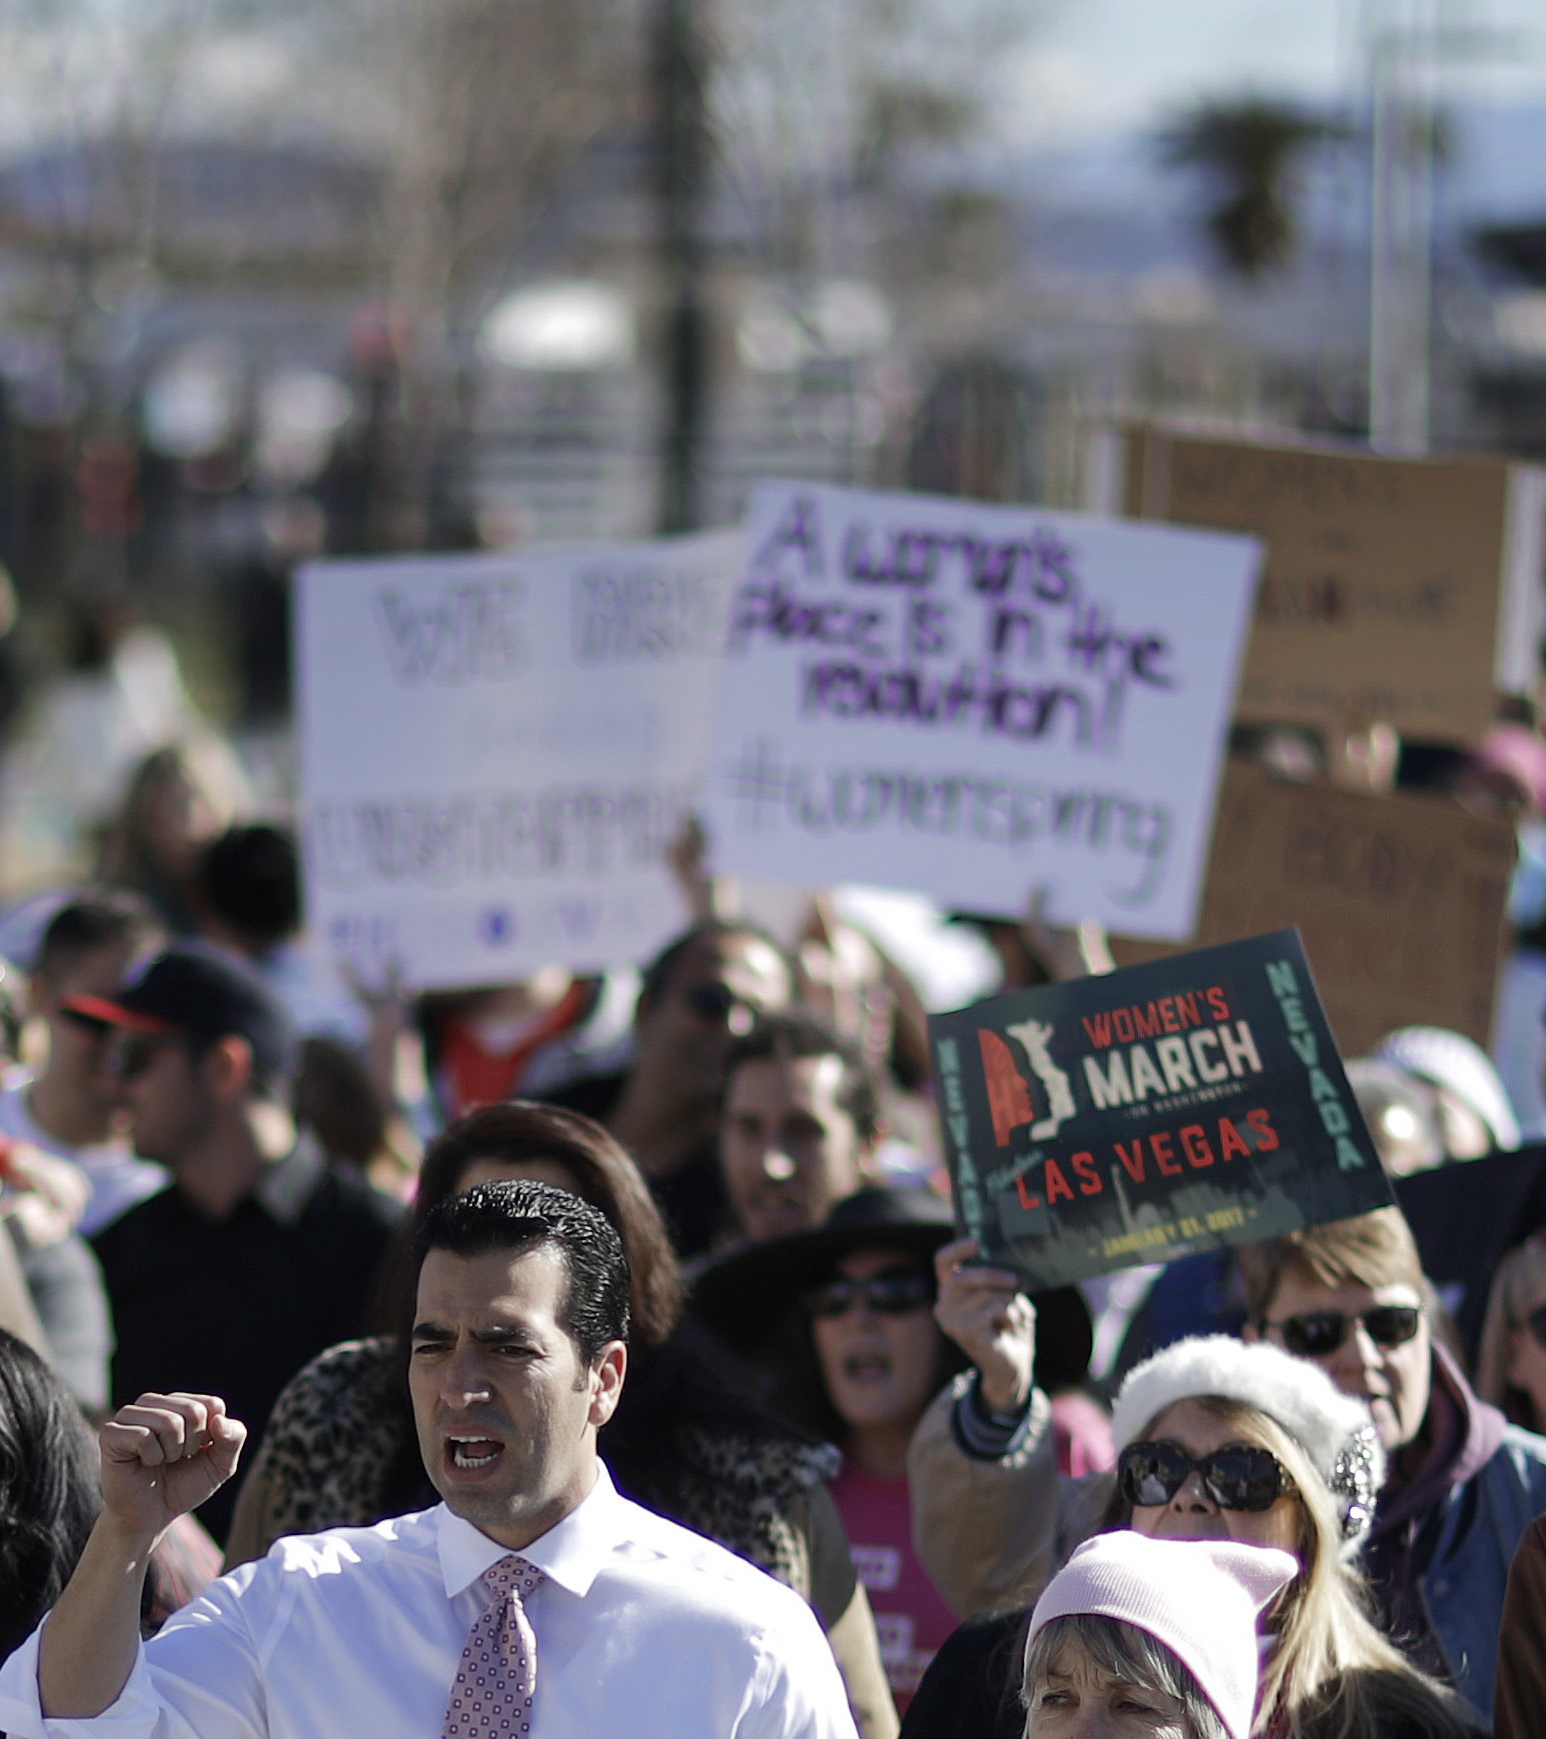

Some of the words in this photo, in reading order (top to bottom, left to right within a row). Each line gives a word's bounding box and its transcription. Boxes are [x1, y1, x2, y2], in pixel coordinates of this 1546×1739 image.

[1081, 986, 1232, 1049] WOMEN'S
[1082, 1020, 1264, 1111] MARCH
[1264, 959, 1364, 1171] NEVADA
[1015, 1151, 1104, 1211] LAS
[1113, 1107, 1281, 1184] VEGAS
